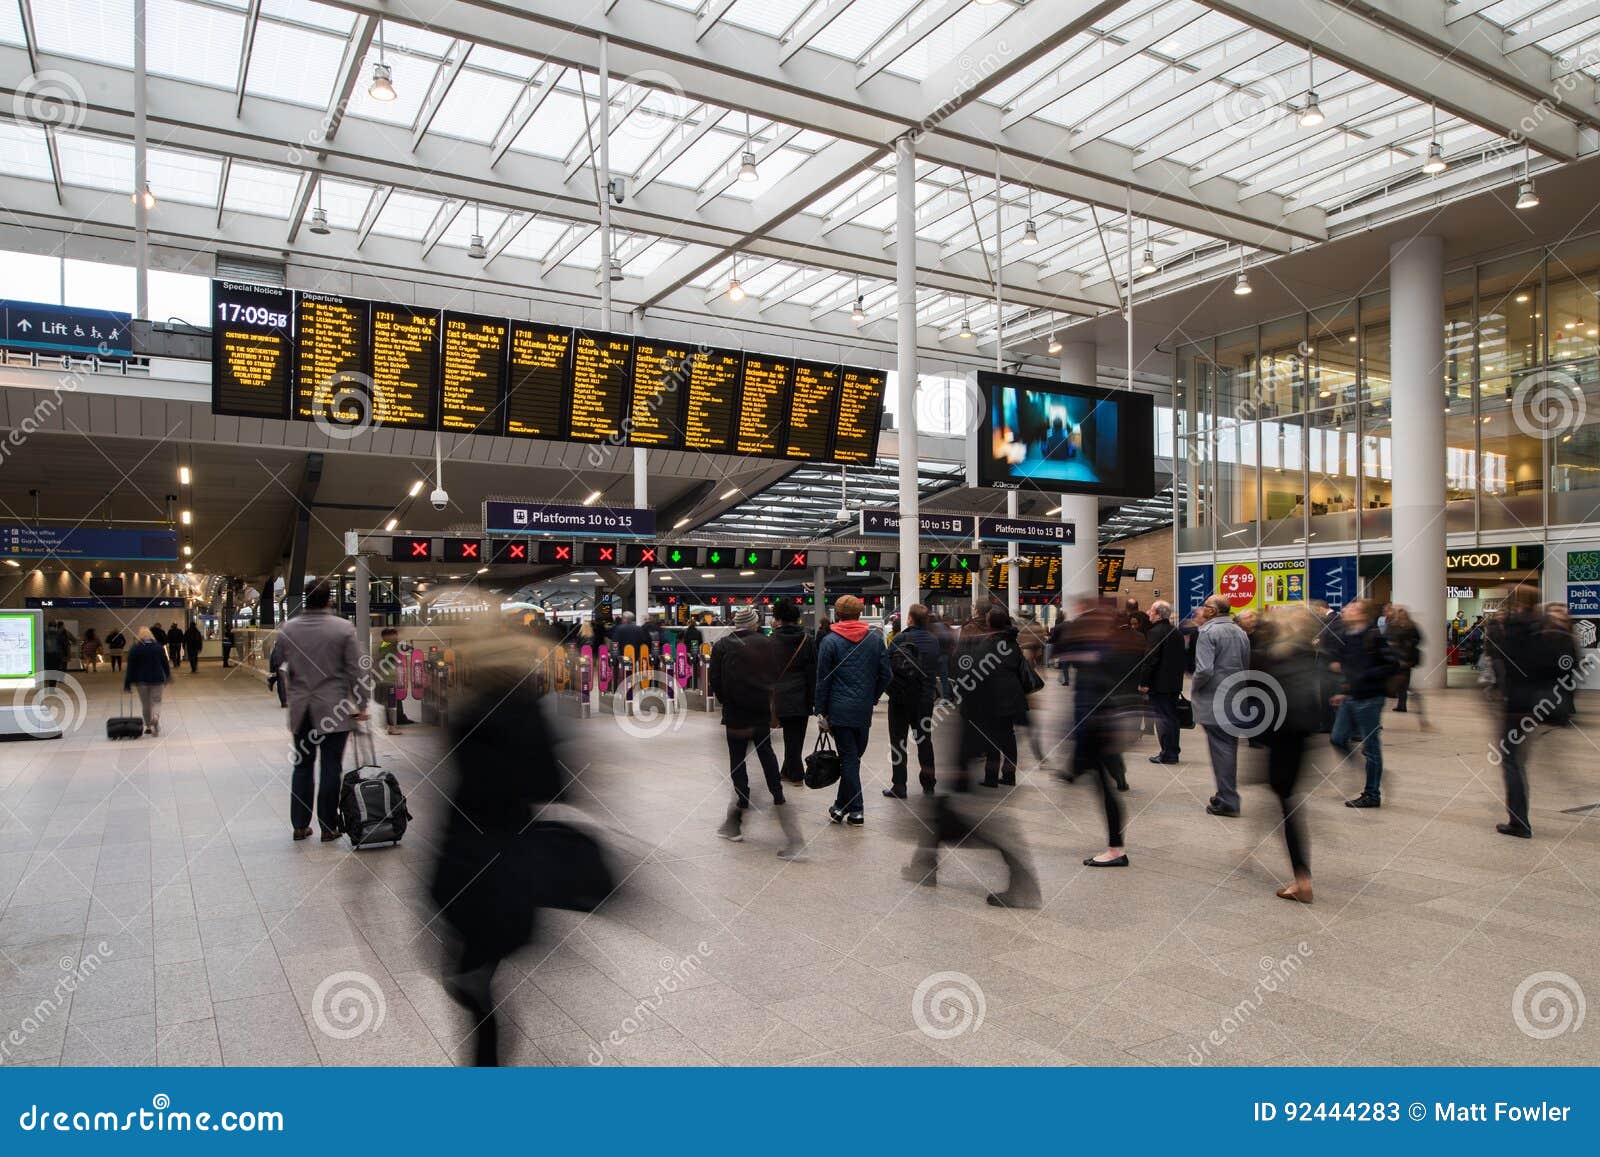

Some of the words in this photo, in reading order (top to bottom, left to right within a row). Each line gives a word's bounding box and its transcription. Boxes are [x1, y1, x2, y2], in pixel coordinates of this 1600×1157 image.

[223, 282, 252, 292] Special
[254, 286, 282, 296] Notices
[302, 292, 343, 304] Departures
[377, 312, 394, 321] 17:11
[42, 322, 68, 336] Lift
[375, 321, 390, 329] West
[393, 324, 420, 333] Croydon
[448, 321, 466, 329] 17:13
[532, 512, 586, 524] Platforms
[588, 515, 602, 525] 10
[604, 516, 616, 526] to
[619, 516, 632, 526] 15
[921, 520, 930, 529] 10
[941, 521, 950, 530] 15
[995, 524, 1026, 535] Platforms
[1027, 527, 1036, 535] 10
[1046, 527, 1053, 536] 15
[1462, 554, 1500, 567] FOOD
[1569, 552, 1598, 564] M&S
[1446, 586, 1473, 598] HSmith
